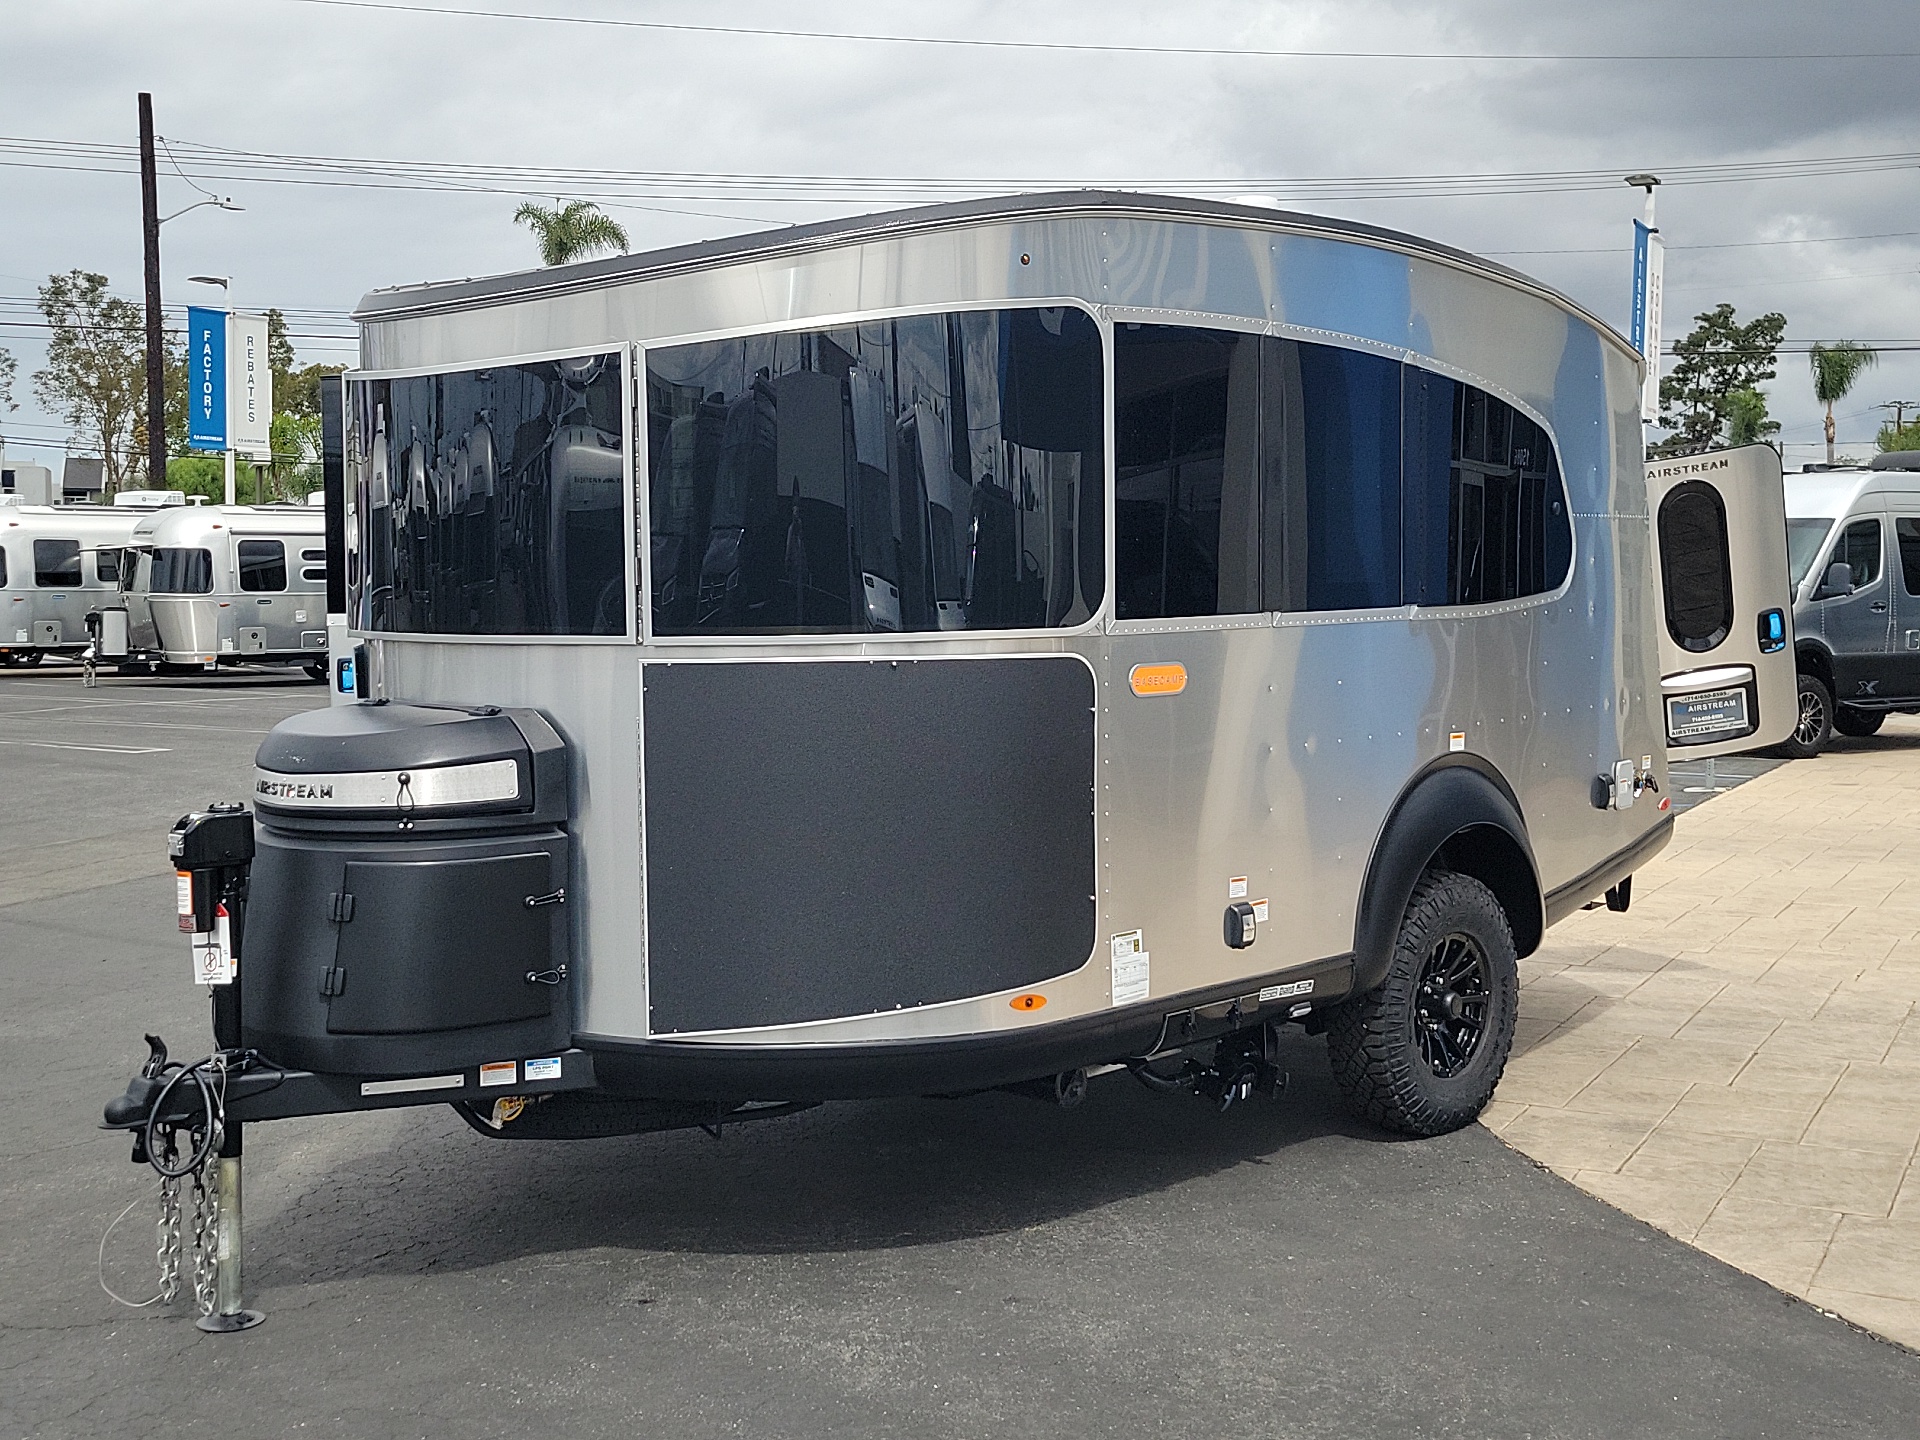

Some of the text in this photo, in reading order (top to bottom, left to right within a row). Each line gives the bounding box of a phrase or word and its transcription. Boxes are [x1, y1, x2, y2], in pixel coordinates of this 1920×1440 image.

[203, 330, 212, 420] FACTORY
[247, 335, 255, 423] REBATES
[1647, 459, 1729, 479] AIRSTREAM
[1135, 675, 1184, 687] BASECAMP
[1688, 699, 1736, 713] AIRSTREAM
[1671, 725, 1711, 736] AIRSTREAM
[256, 778, 333, 798] AIRSTREAM
